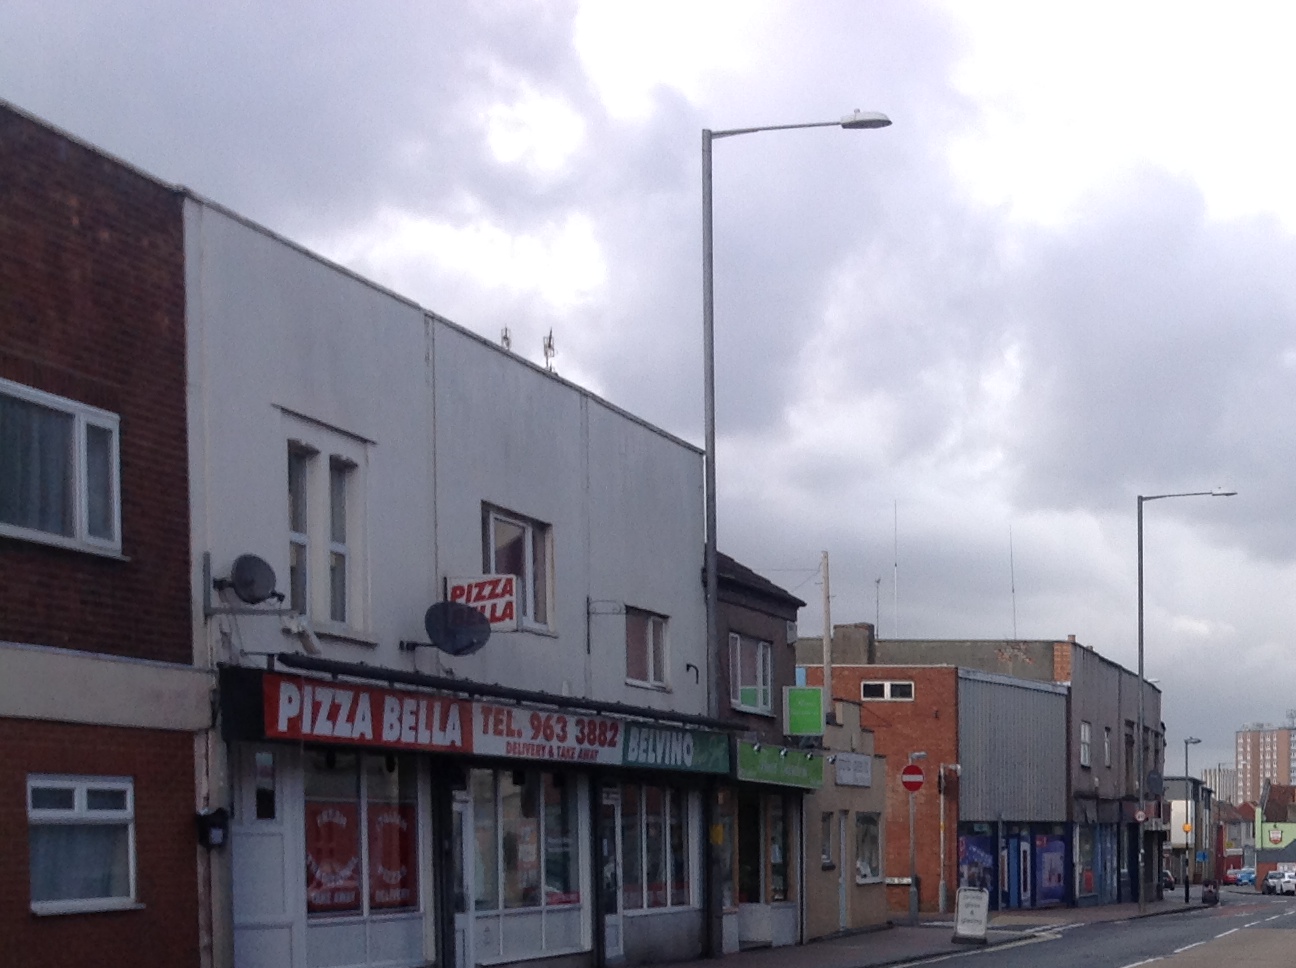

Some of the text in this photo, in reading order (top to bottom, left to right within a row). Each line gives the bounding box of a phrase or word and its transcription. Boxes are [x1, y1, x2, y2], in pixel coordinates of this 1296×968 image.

[450, 578, 513, 603] PIZZA
[453, 601, 513, 624] LLA
[277, 681, 462, 747] PIZZA BELLA
[480, 705, 619, 748] TEL. 963 3882
[506, 741, 599, 761] DELIVERY & TAKE AWAY
[628, 726, 694, 767] BELVINO
